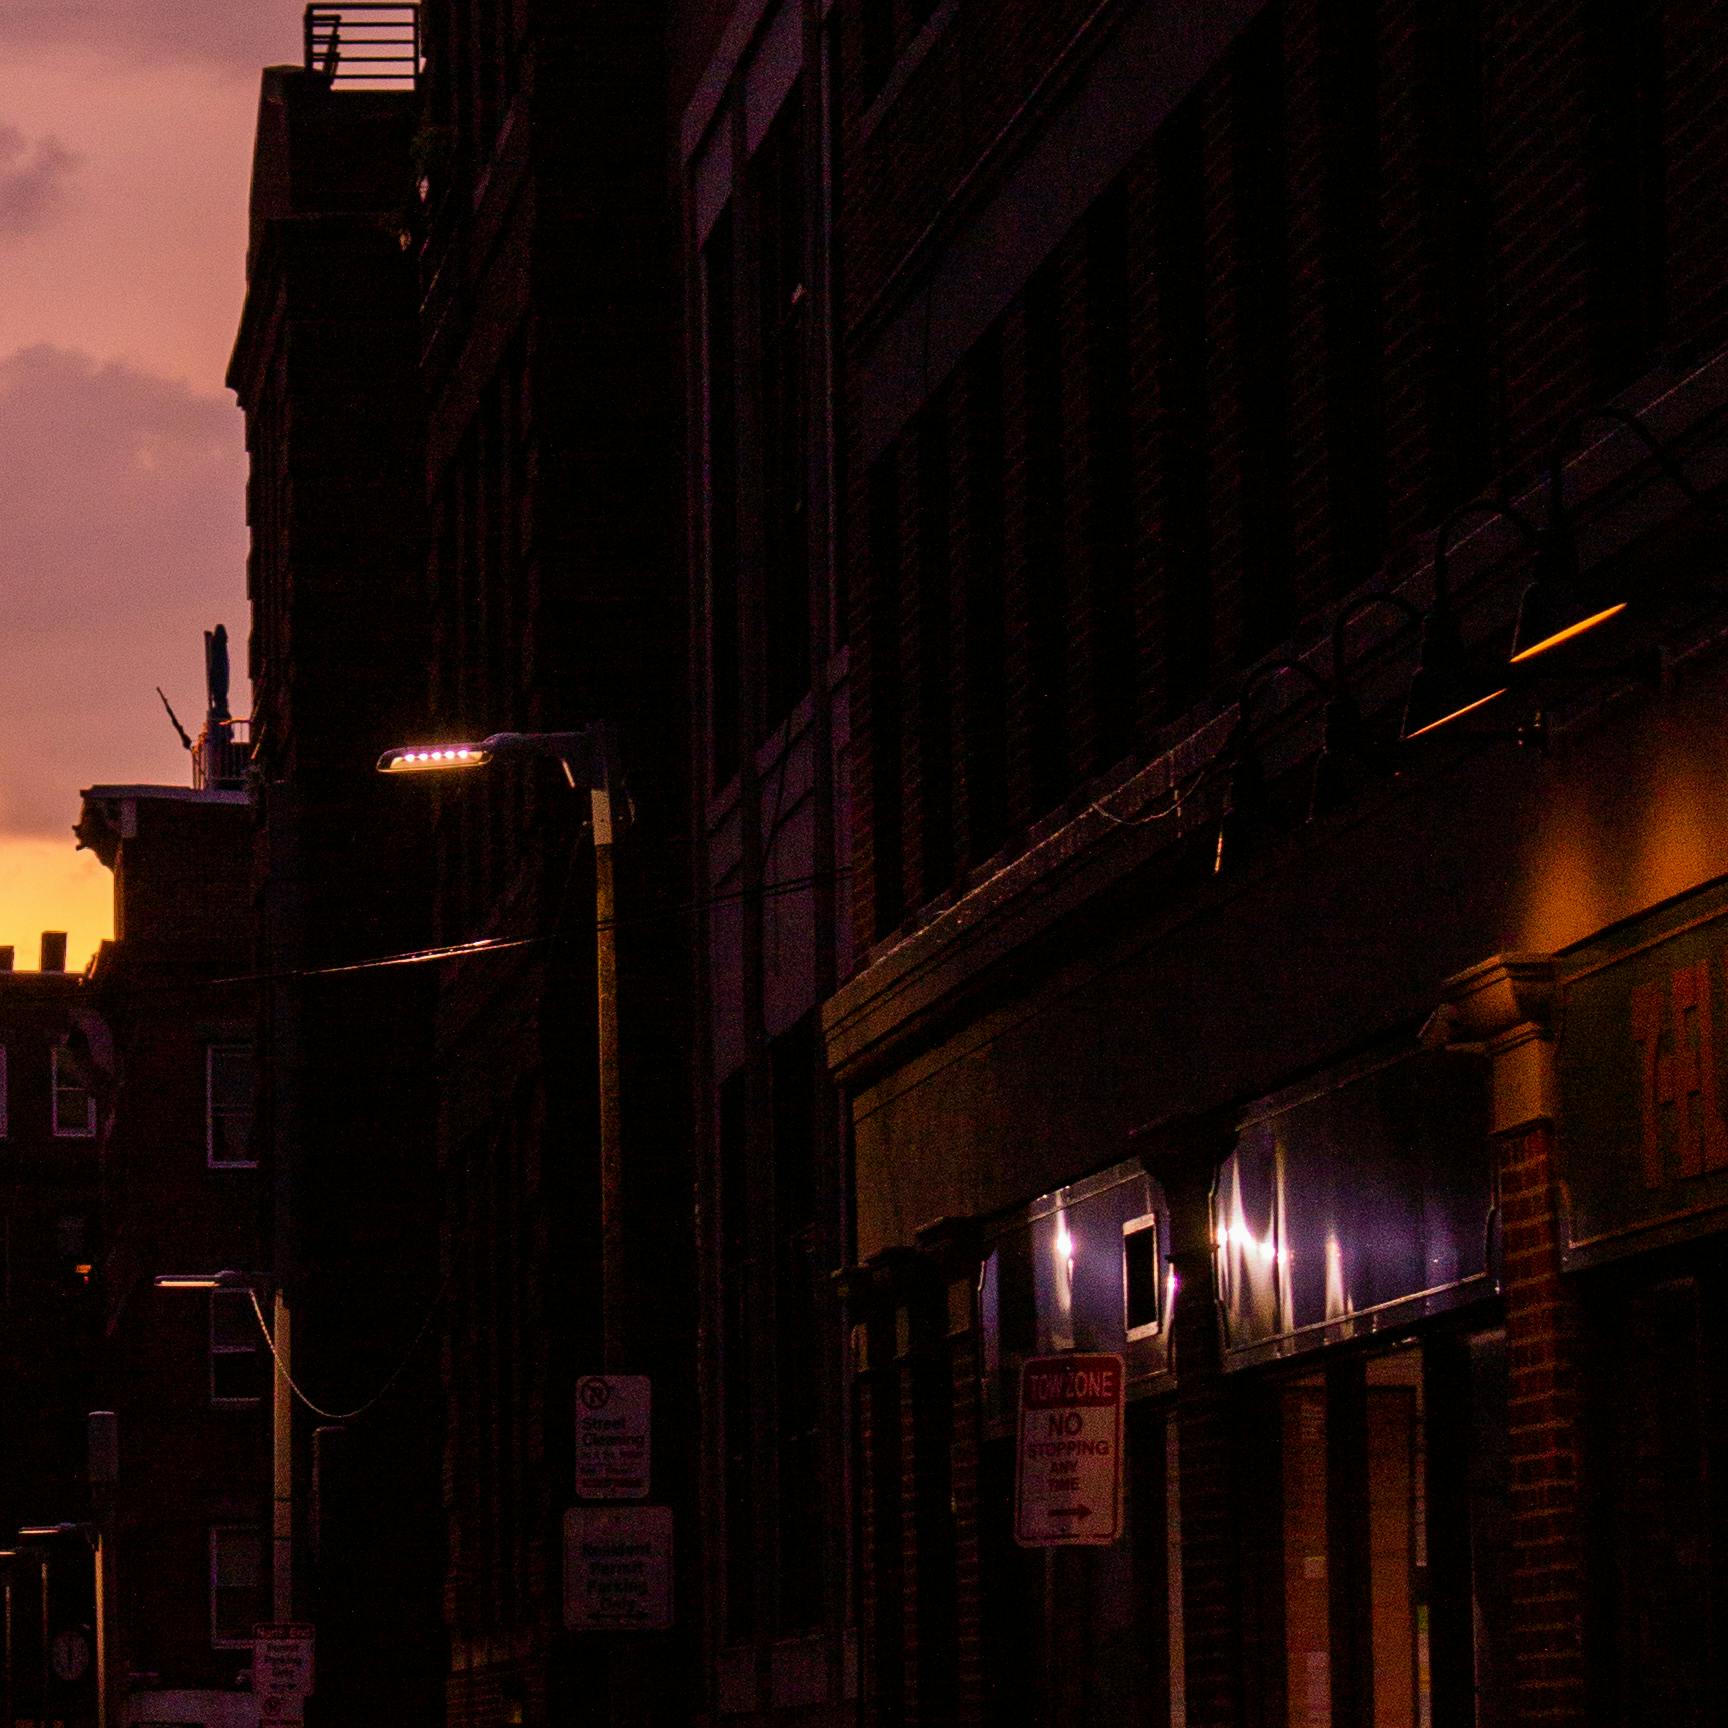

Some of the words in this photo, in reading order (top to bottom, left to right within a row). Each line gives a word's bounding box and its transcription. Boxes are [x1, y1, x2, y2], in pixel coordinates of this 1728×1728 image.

[1029, 1373, 1064, 1401] TOW
[1064, 1370, 1114, 1399] ZONE
[581, 1417, 626, 1431] Street
[1048, 1412, 1083, 1436] NO
[582, 1432, 645, 1448] Cleaning
[1027, 1440, 1110, 1458] STOPPING
[1050, 1460, 1078, 1474] ANY
[1048, 1478, 1080, 1491] TIME
